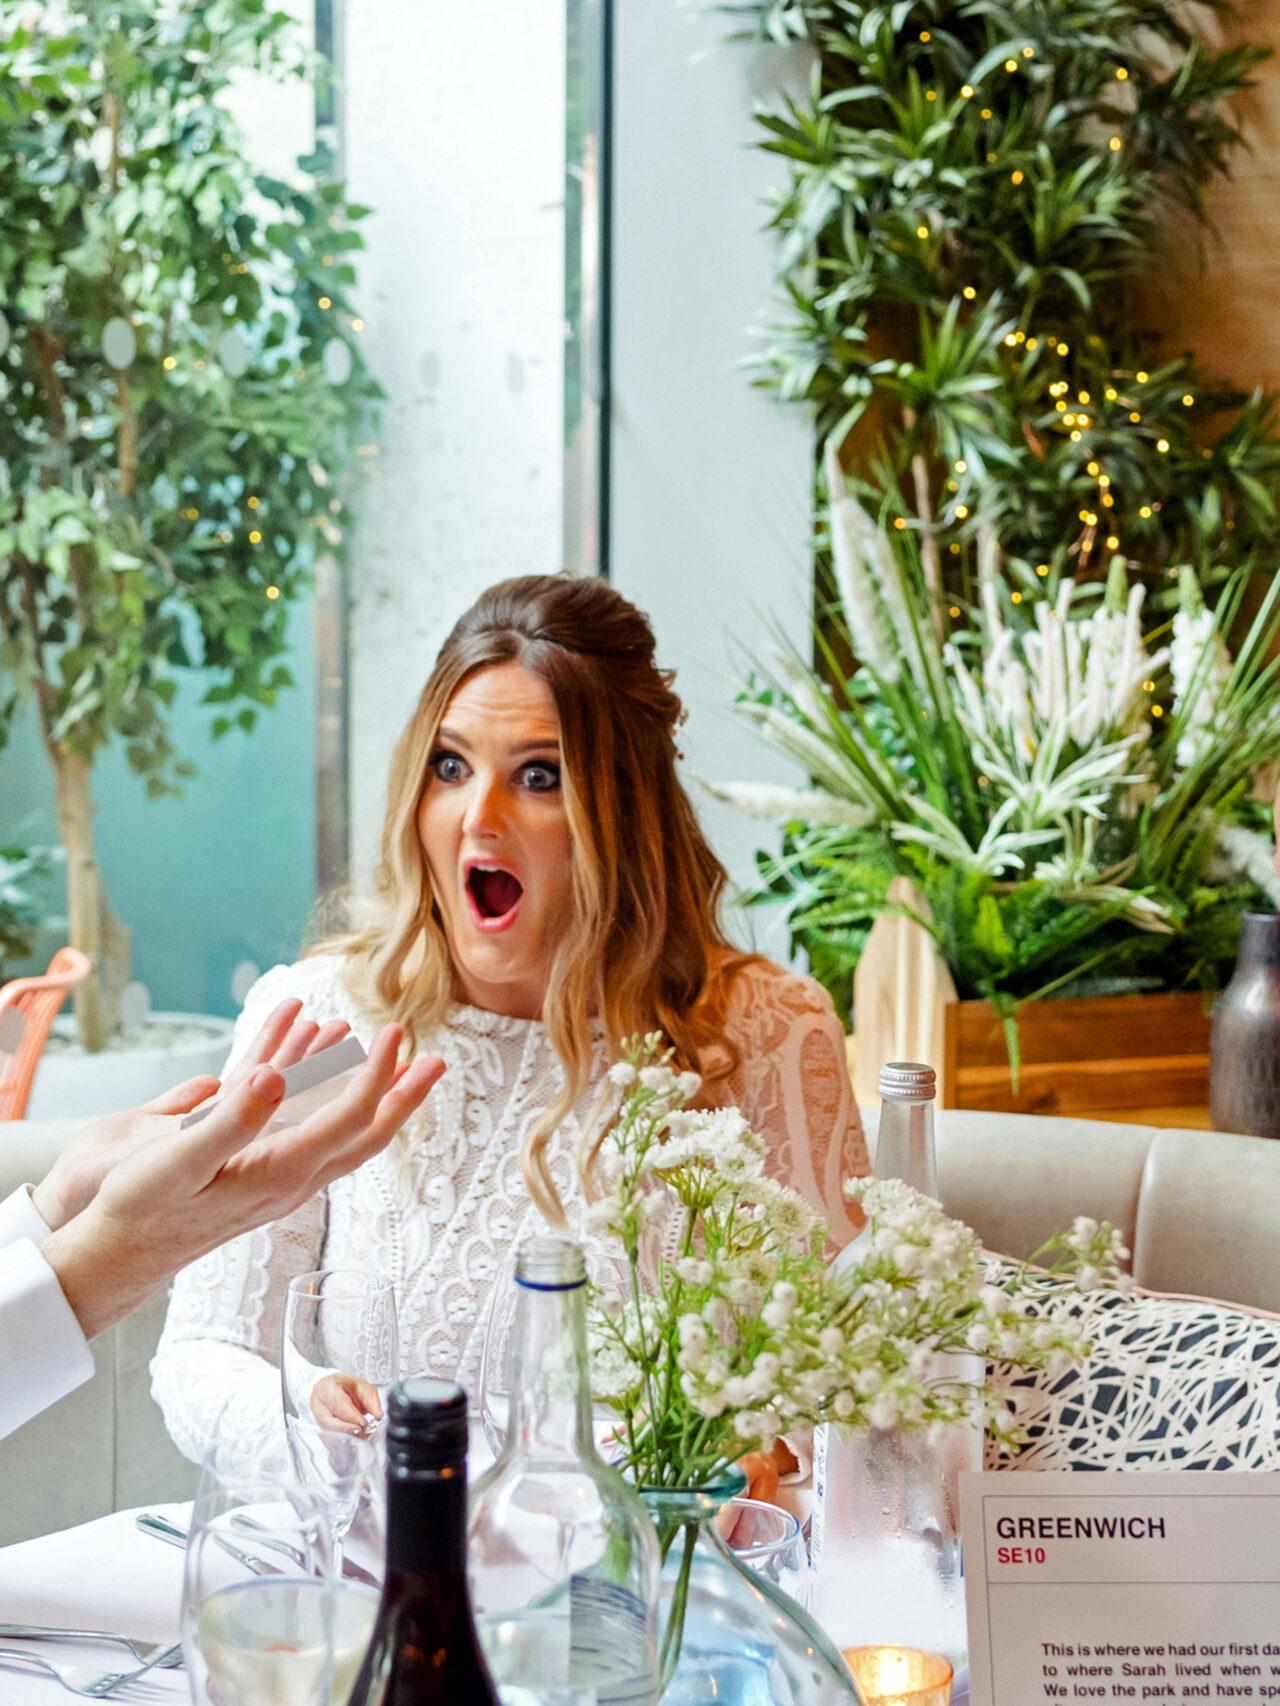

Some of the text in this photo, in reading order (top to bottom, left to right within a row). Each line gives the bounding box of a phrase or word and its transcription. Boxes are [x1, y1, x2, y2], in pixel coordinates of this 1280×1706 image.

[996, 1516, 1166, 1539] GREENWICH
[997, 1547, 1046, 1564] SE10
[1042, 1643, 1074, 1656] This
[1077, 1643, 1091, 1656] is
[1094, 1643, 1141, 1656] where
[1144, 1645, 1165, 1656] we
[1168, 1643, 1197, 1656] had
[1200, 1645, 1226, 1656] our
[1229, 1643, 1259, 1656] first
[1042, 1664, 1058, 1676] to
[1066, 1664, 1113, 1676] where
[1122, 1663, 1166, 1676] Sarah
[1175, 1663, 1211, 1676] lived
[1220, 1663, 1261, 1676] when
[1044, 1683, 1068, 1696] We
[1073, 1683, 1106, 1696] love
[1112, 1683, 1136, 1696] the
[1142, 1683, 1176, 1699] park
[1182, 1683, 1210, 1696] and
[1216, 1683, 1253, 1696] have
